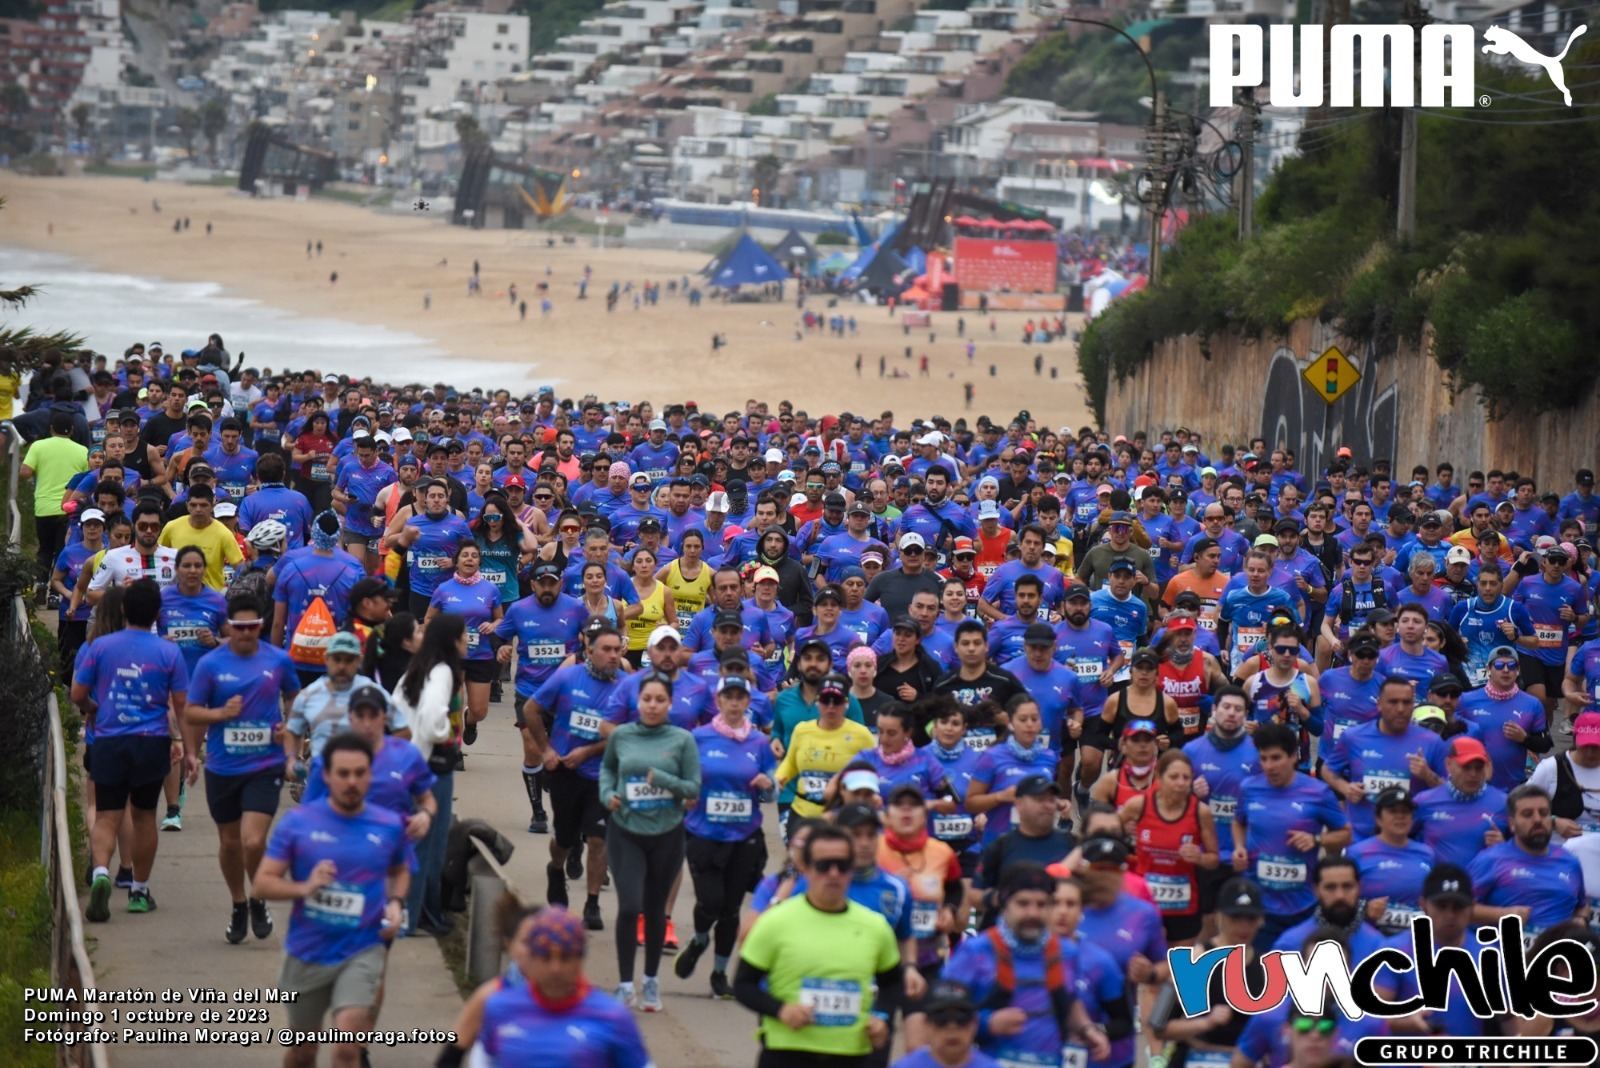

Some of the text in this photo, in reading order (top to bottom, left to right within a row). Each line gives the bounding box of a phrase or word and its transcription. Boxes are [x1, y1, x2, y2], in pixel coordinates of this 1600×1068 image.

[677, 604, 692, 612] CHILE
[1539, 632, 1556, 640] 849
[534, 647, 560, 656] 3524
[117, 667, 139, 679] PUMA
[1075, 666, 1097, 674] 4189
[231, 731, 264, 742] 3209
[714, 801, 745, 812] 5730
[939, 822, 967, 833] 3487
[1265, 865, 1298, 878] 3379
